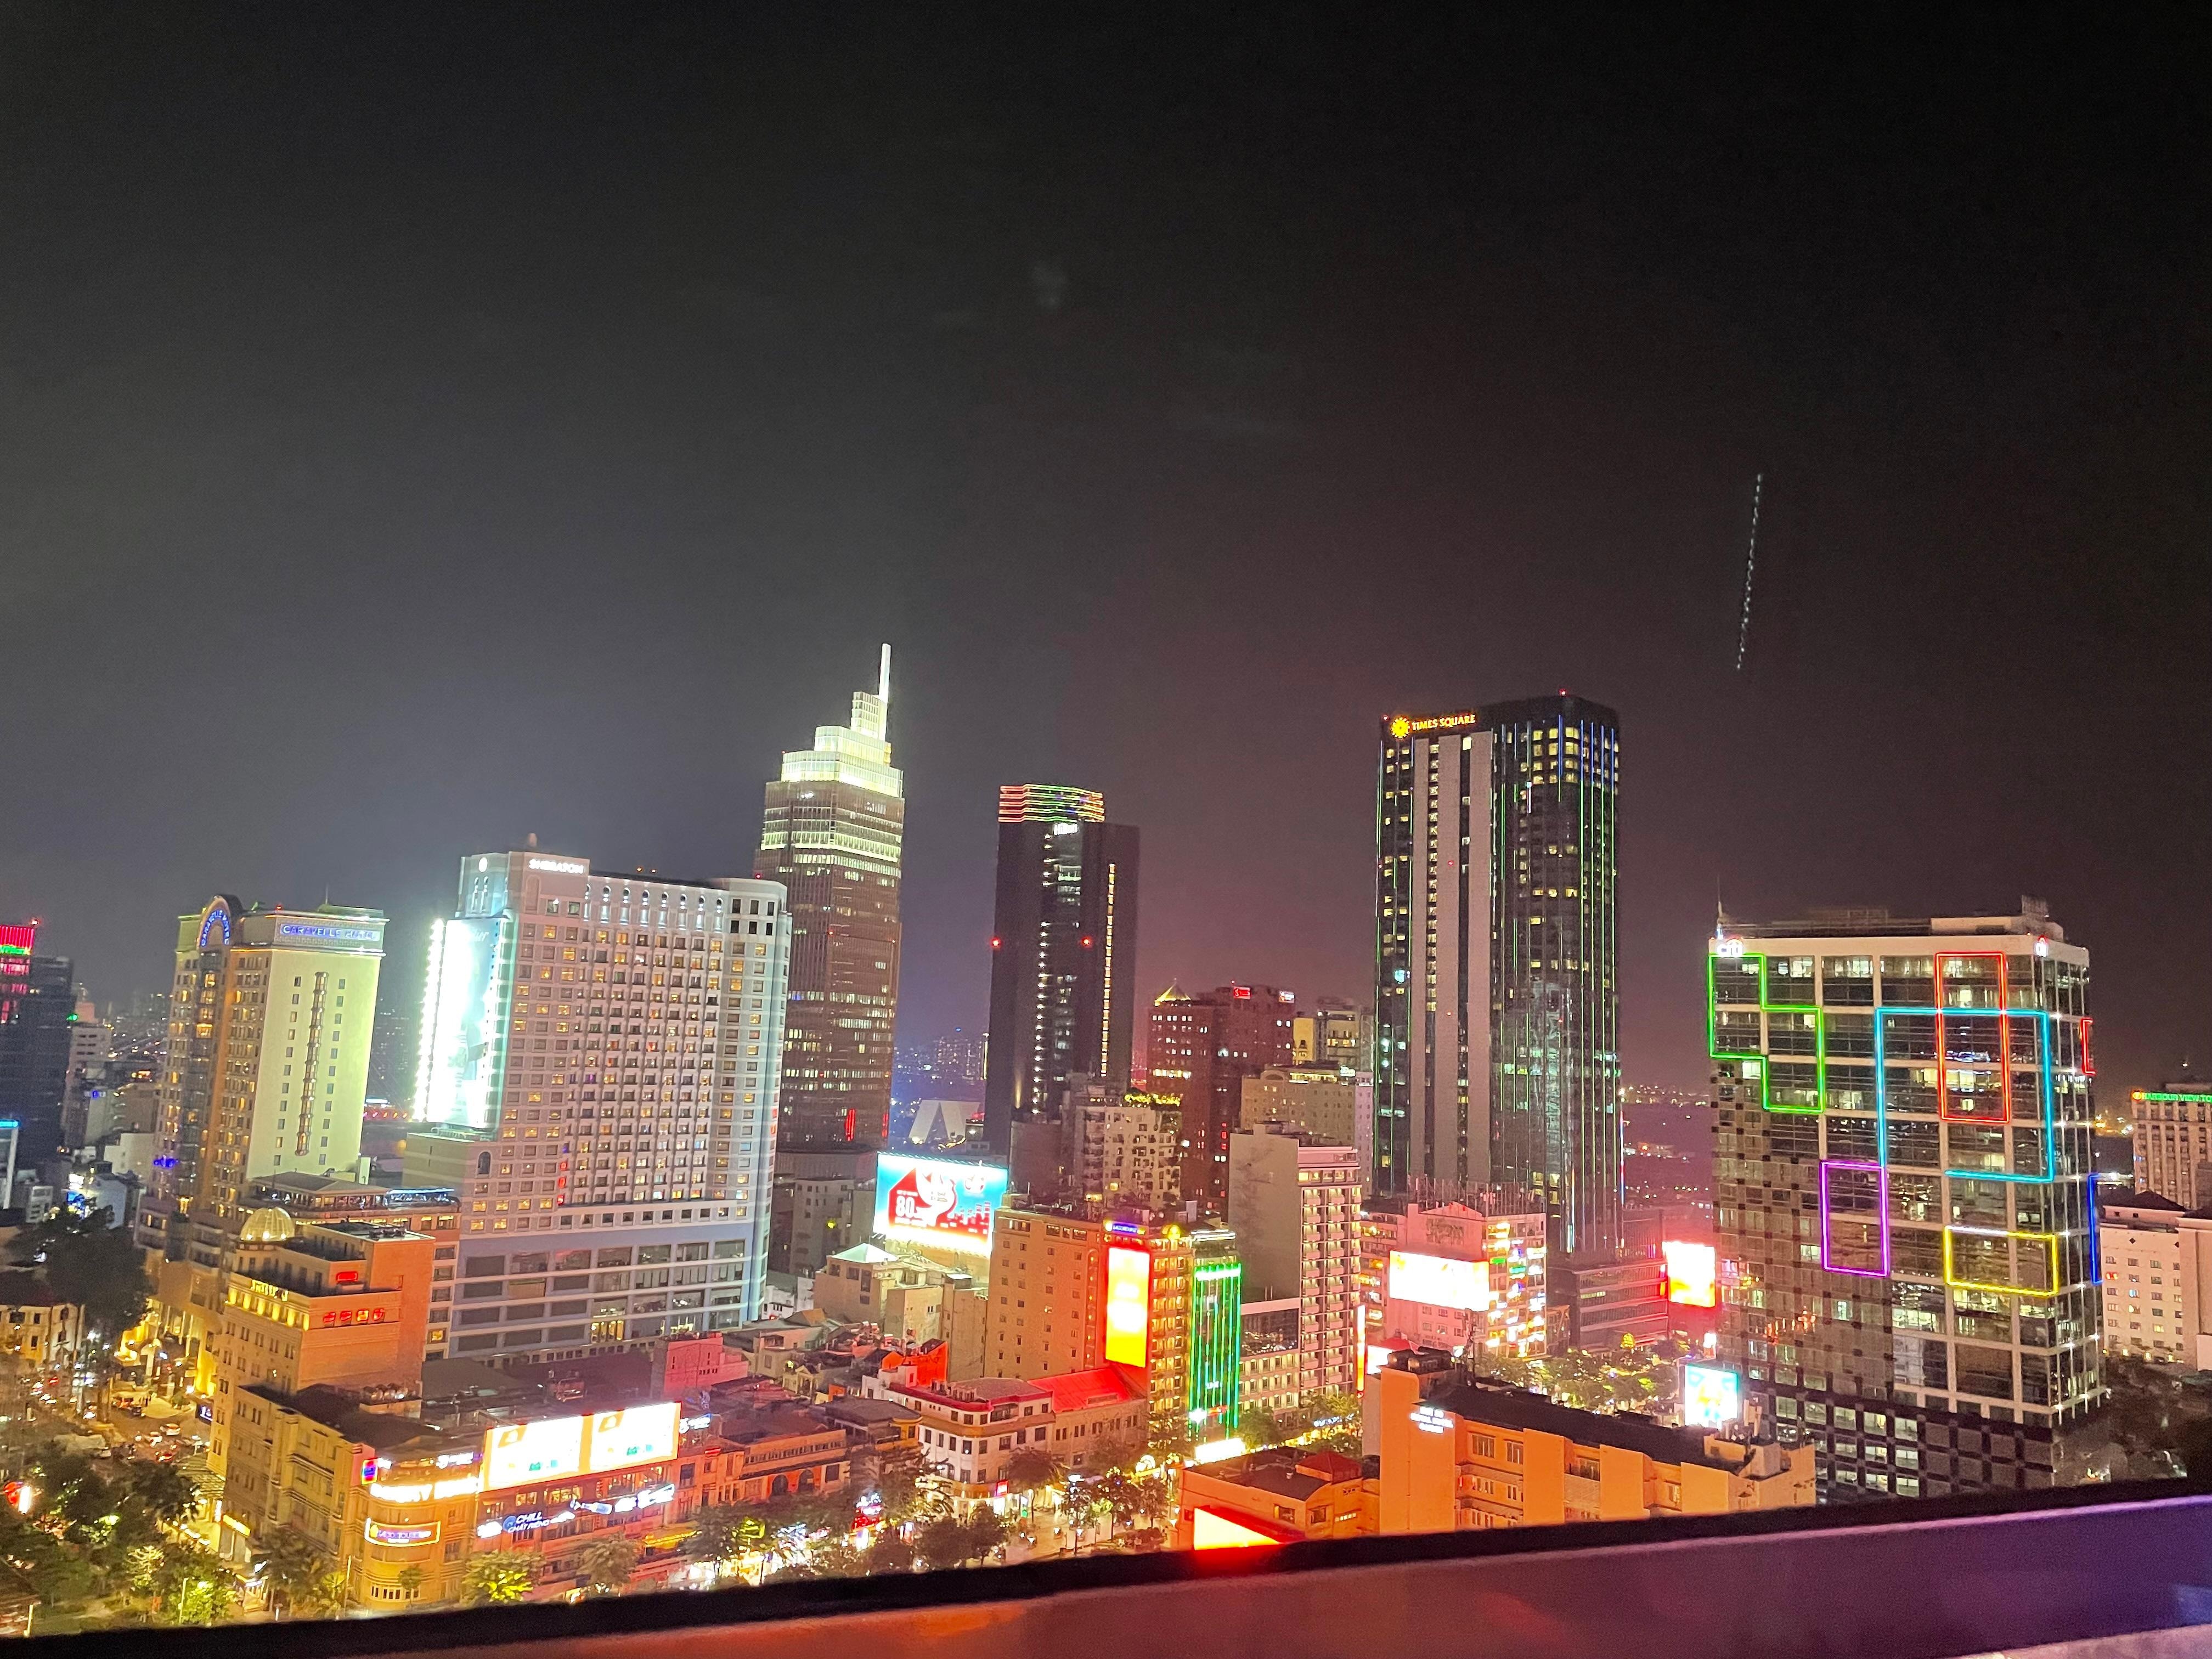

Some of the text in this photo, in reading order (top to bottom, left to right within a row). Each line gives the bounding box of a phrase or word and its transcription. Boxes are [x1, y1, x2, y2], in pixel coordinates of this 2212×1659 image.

[1412, 714, 1476, 731] TIMES SQUARE
[283, 925, 342, 937] CARAVELLE
[895, 1195, 915, 1218] 80
[516, 1511, 543, 1524] CHILL
